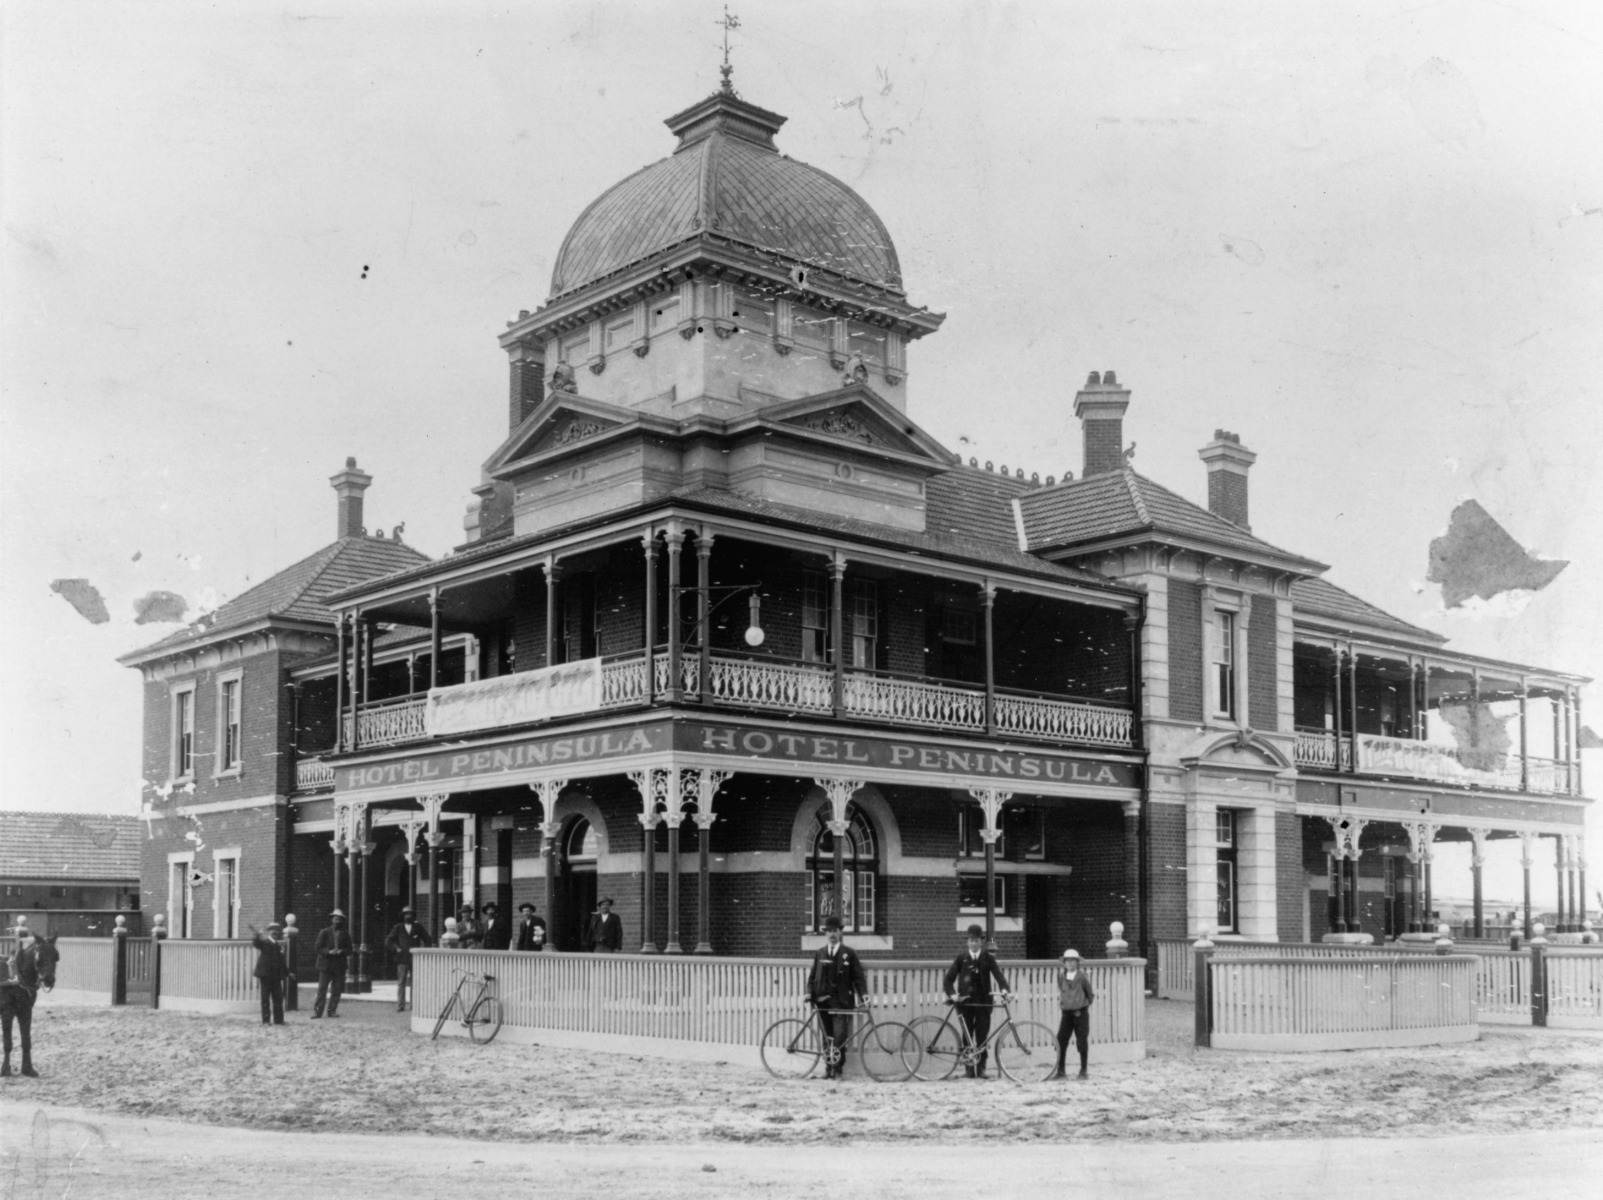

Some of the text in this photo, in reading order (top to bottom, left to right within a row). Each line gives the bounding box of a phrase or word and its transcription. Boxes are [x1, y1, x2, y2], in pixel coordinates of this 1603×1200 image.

[348, 729, 651, 787] HOTEL PENINSULA
[702, 727, 1118, 783] HOTEL PENINSULA
